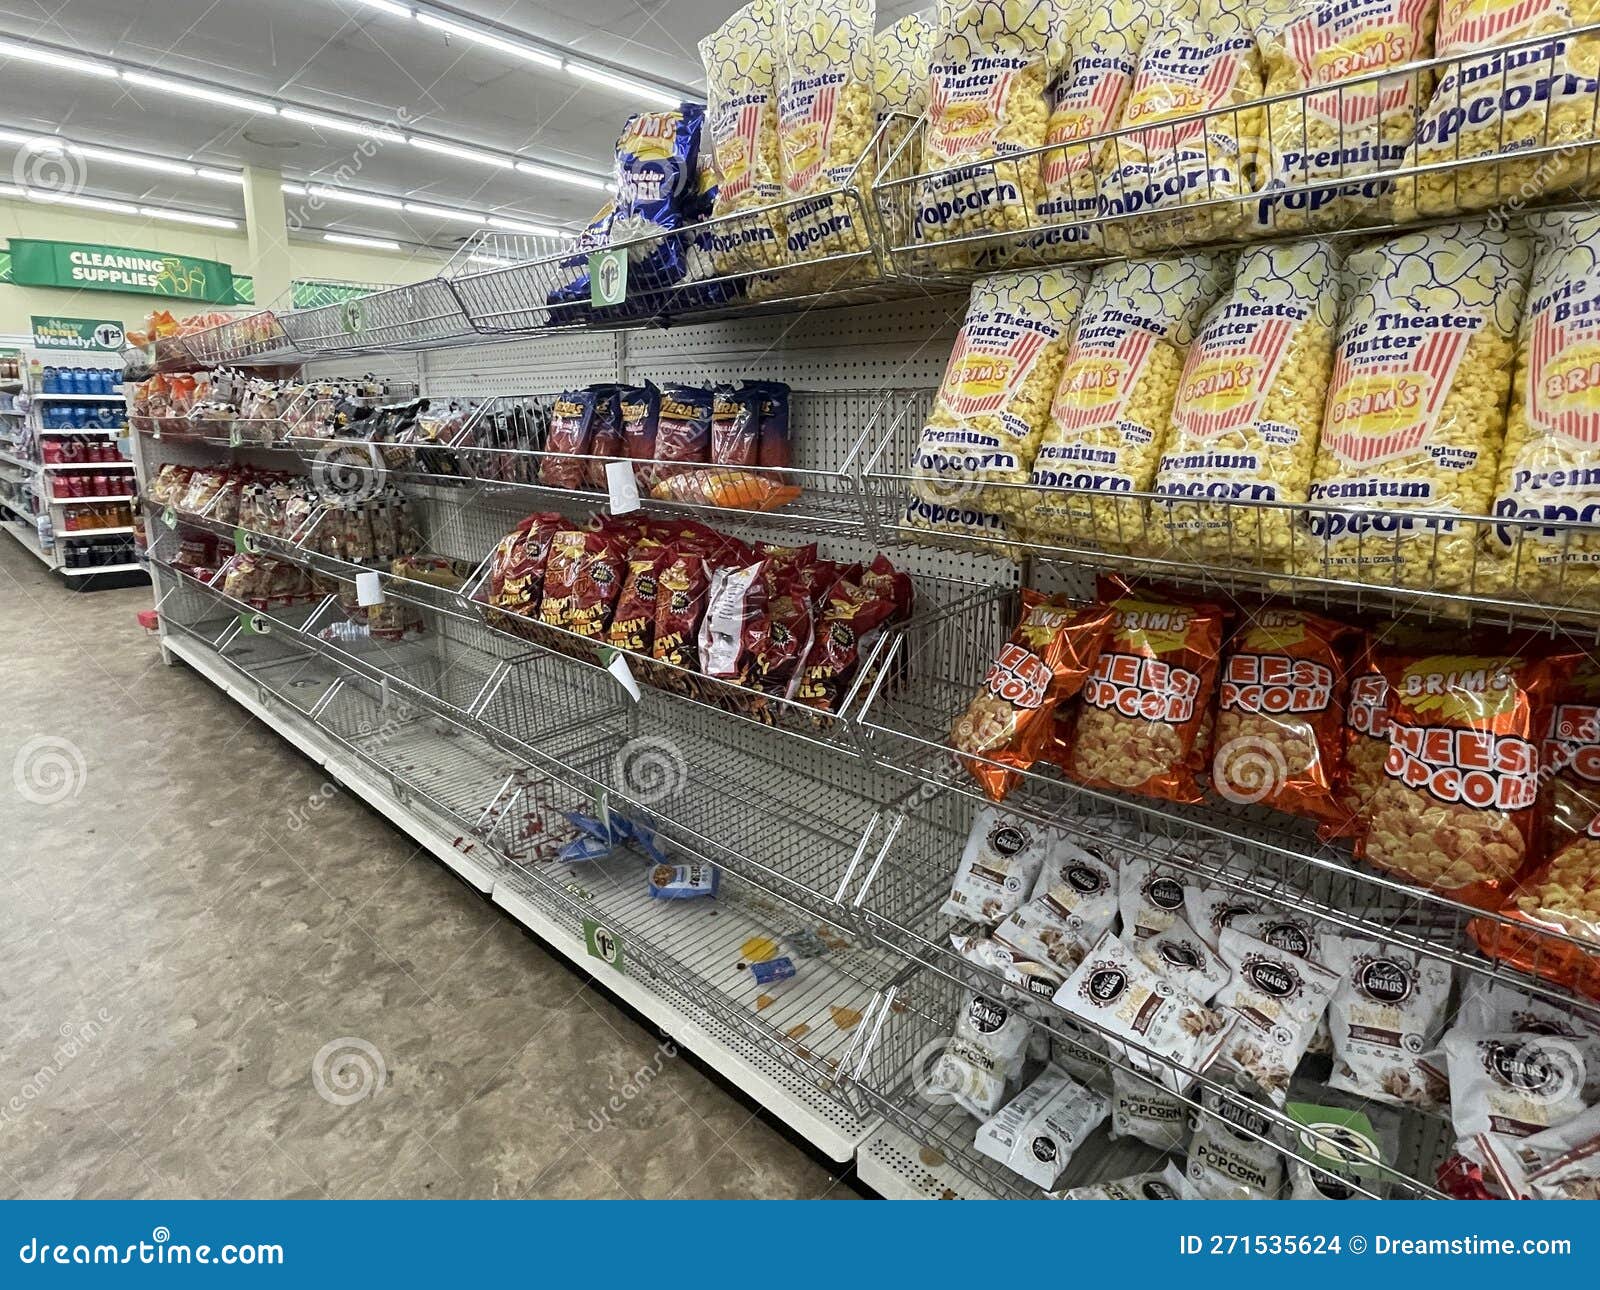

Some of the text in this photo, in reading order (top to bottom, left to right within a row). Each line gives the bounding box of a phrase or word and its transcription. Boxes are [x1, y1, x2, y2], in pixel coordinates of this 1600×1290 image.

[1334, 6, 1391, 32] Flavored
[1178, 38, 1254, 60] Theater
[1319, 32, 1405, 83] BRIM'S
[971, 57, 1029, 73] Theate
[1073, 56, 1135, 76] Theater
[1433, 42, 1566, 101] emium
[791, 72, 846, 94] Theater
[1416, 73, 1598, 146] opcorn
[786, 196, 834, 225] remium
[1038, 196, 1098, 216] mium
[787, 215, 852, 251] opcorn
[70, 251, 165, 273] CLEANING
[72, 267, 160, 288] SUPPLIES
[1530, 279, 1587, 316] Movie
[1102, 309, 1169, 337] Theater
[1224, 302, 1309, 321] Theater
[1375, 312, 1483, 331] Theater
[37, 326, 79, 336] Items
[48, 319, 83, 331] New
[994, 311, 1060, 339] Theater
[1078, 325, 1126, 342] Butter
[1202, 319, 1259, 346] Butter
[34, 335, 97, 349] Weekly!
[1204, 336, 1247, 352] Flavored
[1344, 334, 1423, 359] Butter
[1352, 351, 1409, 367] Flavored
[950, 360, 1009, 386] BRIM'S
[1060, 363, 1120, 396] BRIM'S
[1184, 360, 1254, 403] BRIM'S
[1546, 361, 1600, 400] BRI
[1332, 379, 1421, 423] BRIM'S
[922, 428, 1000, 448] Premium
[1116, 420, 1153, 438] "gluten
[1254, 420, 1299, 437] "gluten
[1158, 450, 1258, 473] Premium
[1424, 444, 1479, 459] "gluten
[1439, 457, 1474, 470] free"
[1032, 470, 1132, 492] opcorn
[1308, 479, 1431, 500] Premium
[1514, 467, 1600, 493] Prem
[1303, 509, 1458, 541] opcorn
[1496, 496, 1600, 546] Popc
[1221, 654, 1332, 690] EESE
[1405, 660, 1513, 696] BRIM'S
[1084, 678, 1194, 723] OPCORN
[1219, 682, 1331, 712] PCORN
[1384, 744, 1538, 810] OPCORN
[1100, 974, 1121, 998] CHAOS
[1255, 968, 1289, 991] CHAOS
[1368, 978, 1404, 993] CHAOS
[972, 1001, 1002, 1027] CHAOS
[1120, 1099, 1182, 1119] POPCORN
[1197, 1145, 1267, 1188] POPCORN
